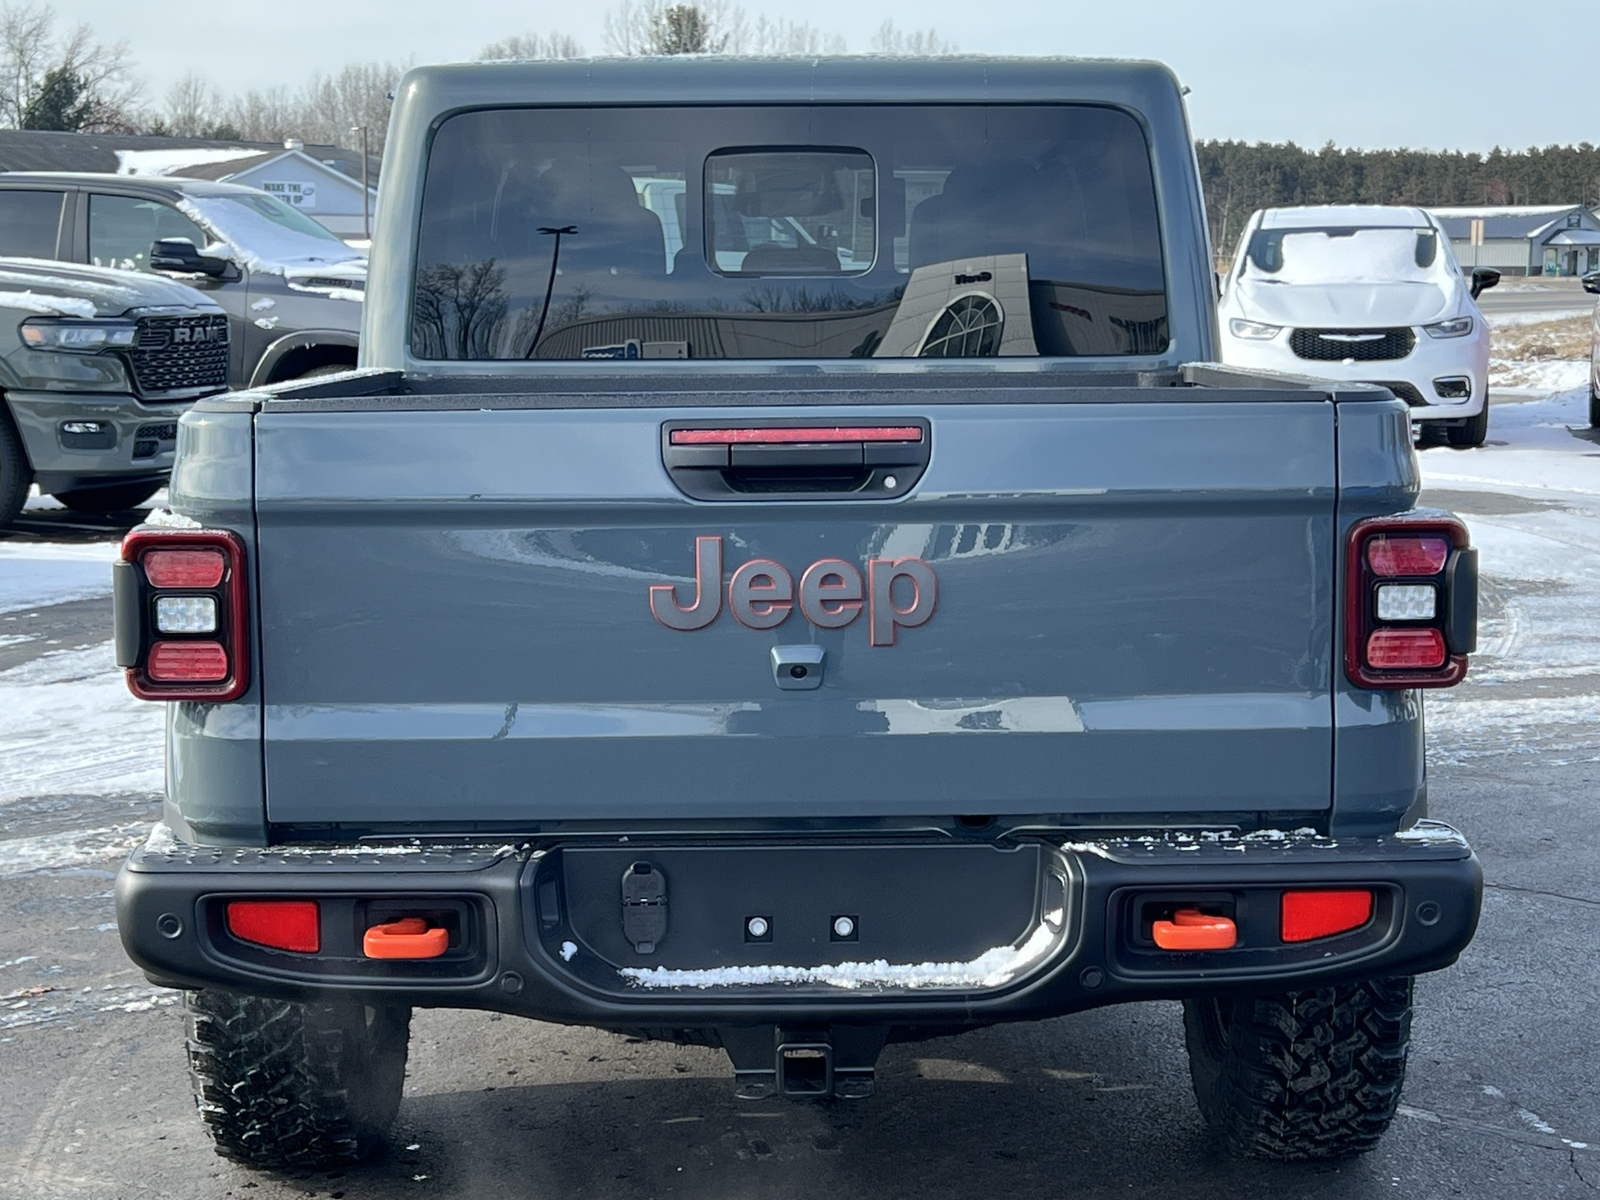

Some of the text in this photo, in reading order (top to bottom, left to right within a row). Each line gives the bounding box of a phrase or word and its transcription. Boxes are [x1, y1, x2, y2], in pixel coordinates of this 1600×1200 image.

[263, 183, 302, 193] WAKE THE
[293, 195, 304, 204] UP
[173, 326, 219, 343] RAM
[649, 536, 938, 647] Jeep
